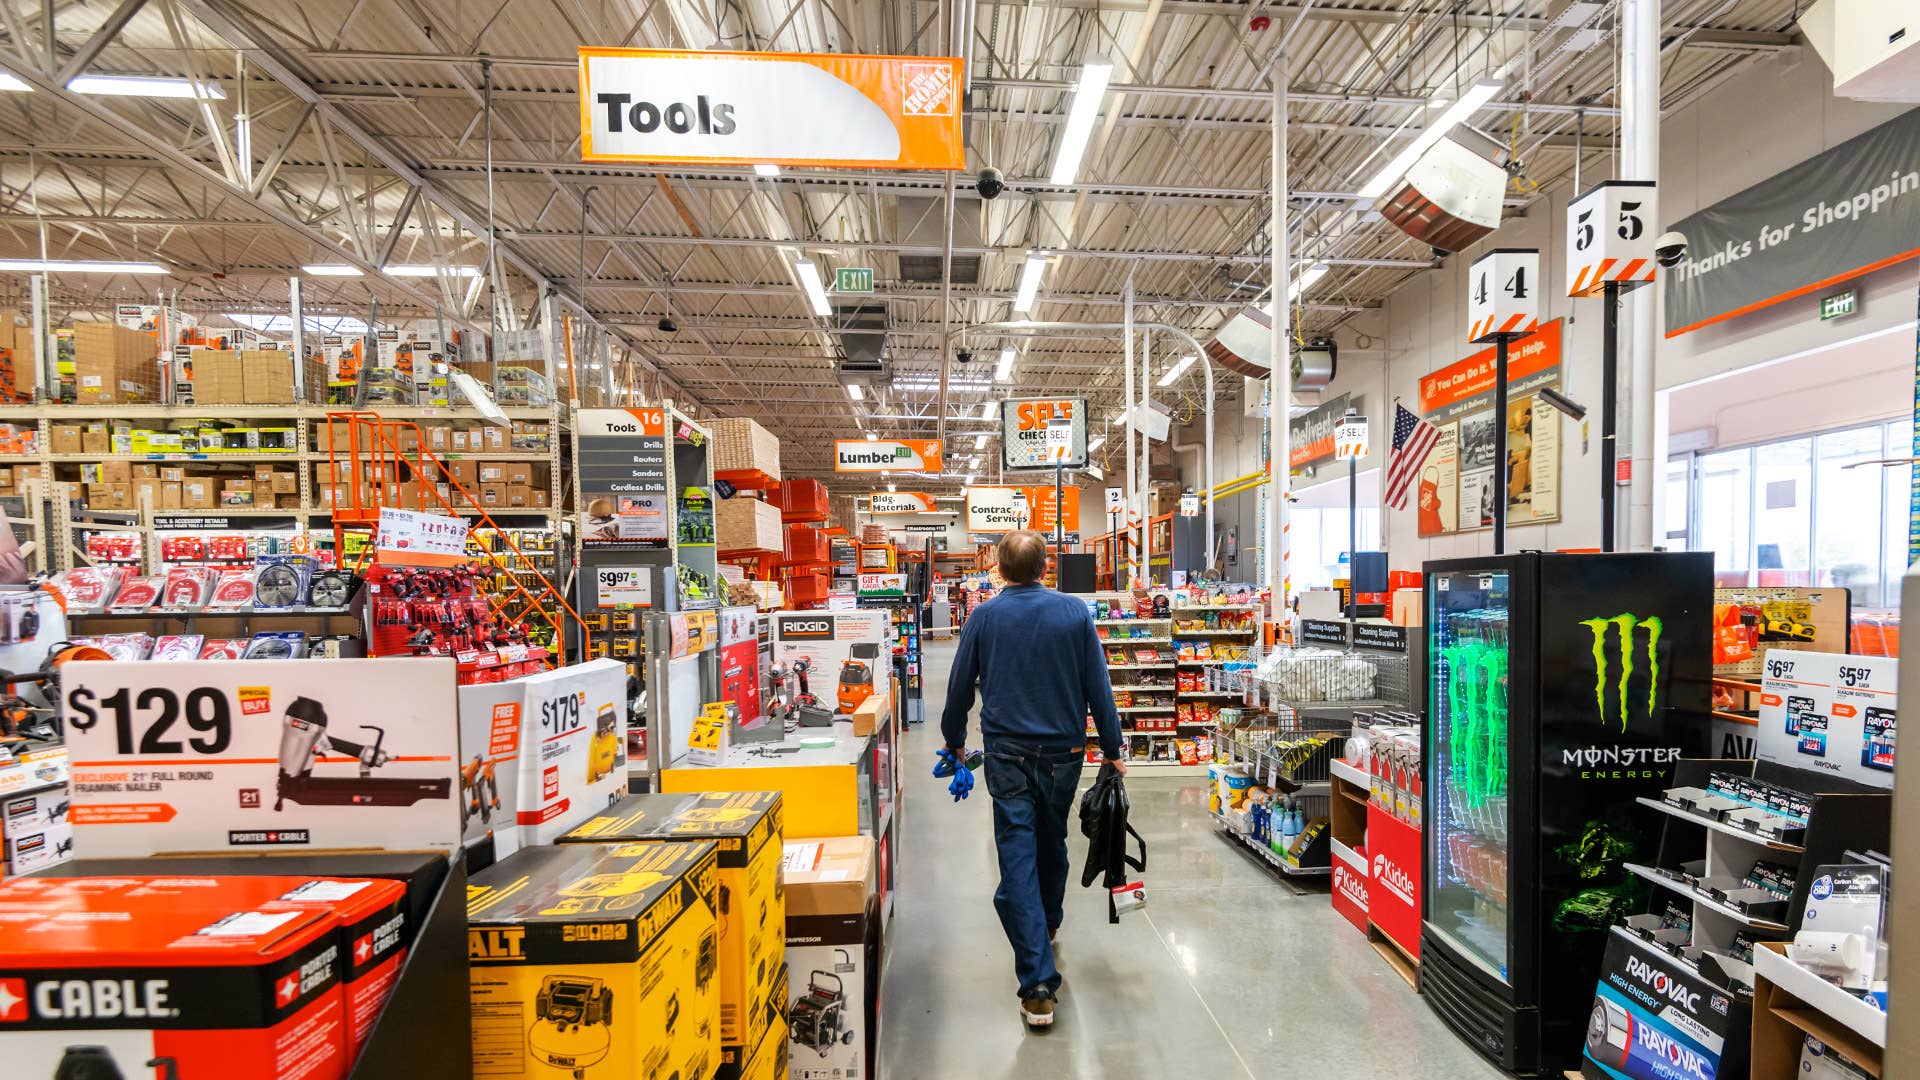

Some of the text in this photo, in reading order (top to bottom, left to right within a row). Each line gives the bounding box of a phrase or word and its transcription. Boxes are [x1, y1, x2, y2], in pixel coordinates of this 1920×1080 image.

[905, 66, 952, 114] HOME
[597, 92, 737, 136] Tools
[1576, 207, 1594, 251] 5
[1617, 201, 1643, 241] 5
[1677, 240, 1753, 283] Thanks
[1757, 221, 1796, 251] for
[841, 271, 869, 290] EXIT
[1474, 271, 1488, 305] 4
[1504, 266, 1529, 299] 4
[1825, 292, 1853, 318] EXIT
[1437, 378, 1451, 392] You
[1452, 372, 1466, 385] Can
[1467, 366, 1478, 380] Do
[1522, 340, 1546, 358] Help.
[606, 412, 662, 433] Tools 16
[1050, 430, 1070, 439] SELF
[633, 455, 663, 463] Routers
[839, 452, 896, 464] Lumber
[632, 469, 664, 477] Sanders
[645, 483, 665, 491] Drills
[1111, 491, 1119, 502] 2
[872, 496, 896, 504] Bldg.
[872, 504, 916, 512] Materials
[862, 576, 880, 584] GIFT
[783, 621, 830, 632] RIDGID
[1308, 622, 1341, 633] Cleaning Supplies
[1359, 627, 1399, 639] Cleaning Supplies
[239, 688, 269, 696] SPECIAL
[243, 700, 267, 712] BUY
[494, 704, 514, 719] FREE
[542, 693, 580, 735] $179
[69, 684, 232, 755] $129
[1562, 744, 1682, 768] MONSTER
[1814, 759, 1842, 772] RAYOVAC
[152, 771, 176, 781] FULL
[179, 771, 213, 781] ROUND
[1581, 769, 1666, 779] ENERGY
[74, 782, 162, 793] FRAMING NAILER
[231, 832, 308, 843] PORTER CABLE
[1343, 869, 1369, 905] Kidde
[1384, 858, 1414, 897] Kidde
[373, 912, 405, 942] PORTER
[373, 928, 400, 956] CABLE
[300, 944, 338, 979] PORTER
[300, 963, 333, 995] CABLE
[1625, 955, 1702, 1015] RAYOVAC
[1609, 972, 1662, 1009] HIGH ENERGY
[1711, 1000, 1728, 1015] USA
[1670, 1007, 1710, 1038] LONG LASTING
[1637, 1021, 1708, 1080] RAYOVAC
[1651, 1059, 1674, 1079] HIGH
